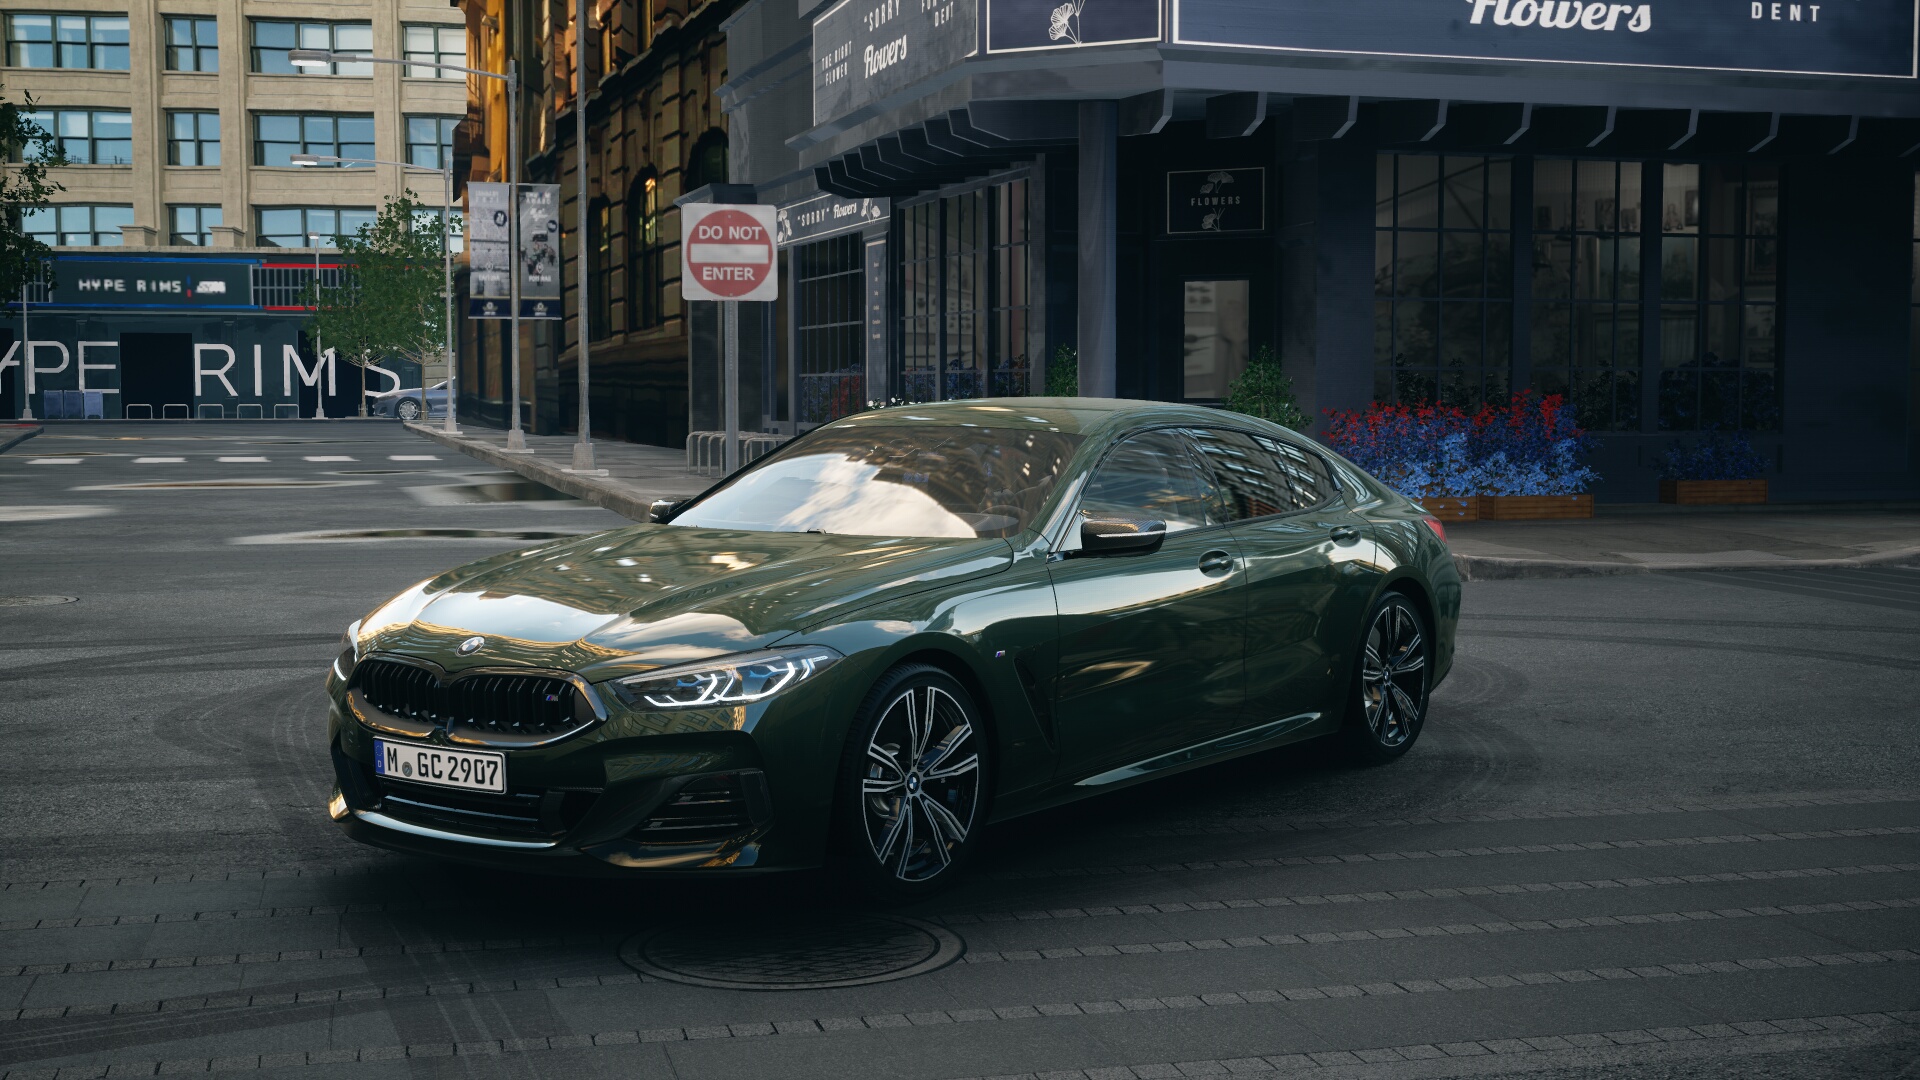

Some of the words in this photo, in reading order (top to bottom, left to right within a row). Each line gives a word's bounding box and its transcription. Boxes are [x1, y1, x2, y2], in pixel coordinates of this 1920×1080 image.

[934, 1, 954, 27] DENT
[1751, 1, 1820, 22] DENT
[821, 53, 832, 71] THE
[834, 40, 852, 63] RIGHT
[864, 34, 908, 79] Flowers
[825, 62, 848, 87] FLOWER
[833, 202, 857, 219] Flowers
[1190, 195, 1241, 206] FLOWERS
[698, 225, 723, 240] DO
[728, 226, 763, 240] NOT
[702, 266, 755, 281] ENTER
[78, 278, 127, 292] HYPE
[136, 279, 182, 293] RIMS
[387, 746, 399, 773] M
[417, 751, 443, 779] GC
[447, 755, 499, 786] 2907
